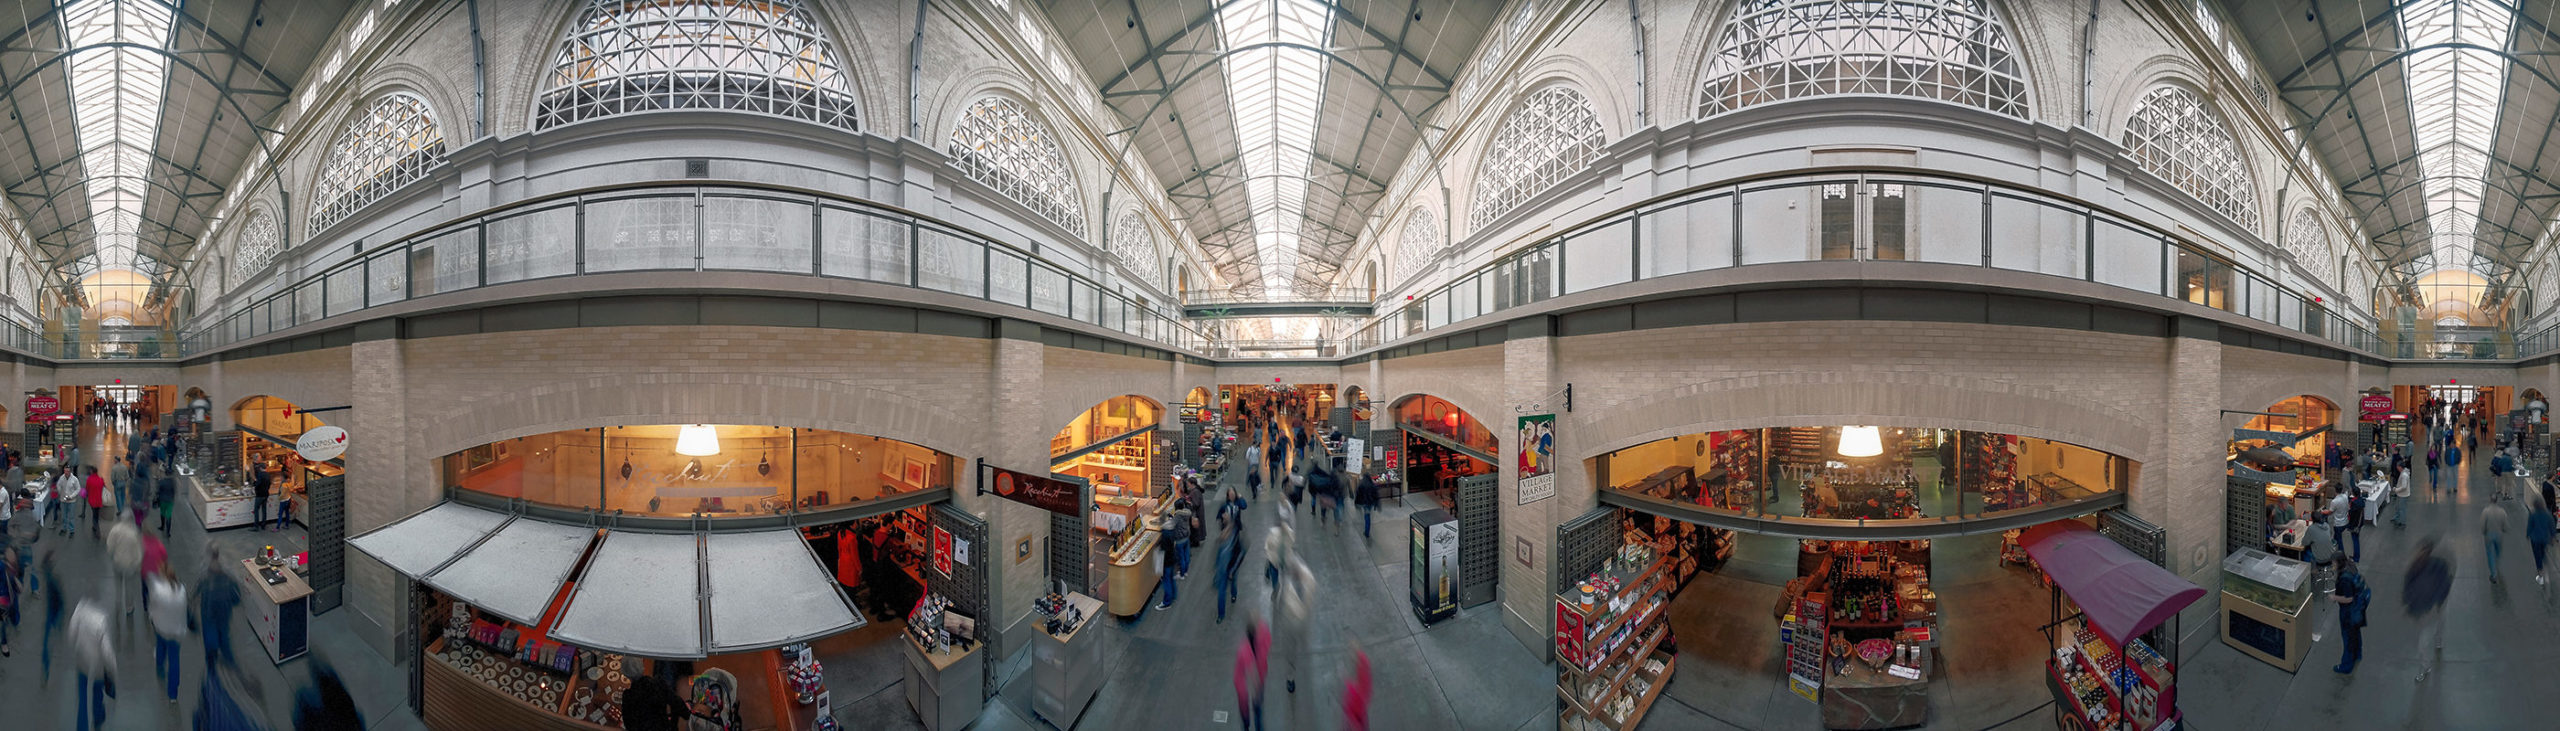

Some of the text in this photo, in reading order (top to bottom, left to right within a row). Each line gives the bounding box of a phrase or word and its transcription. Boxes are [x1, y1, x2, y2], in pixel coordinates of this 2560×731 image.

[299, 438, 336, 450] MARIPOSA
[1778, 464, 1860, 483] VILLAGE
[1522, 474, 1553, 487] VILLAGE
[1522, 482, 1552, 496] MARKET
